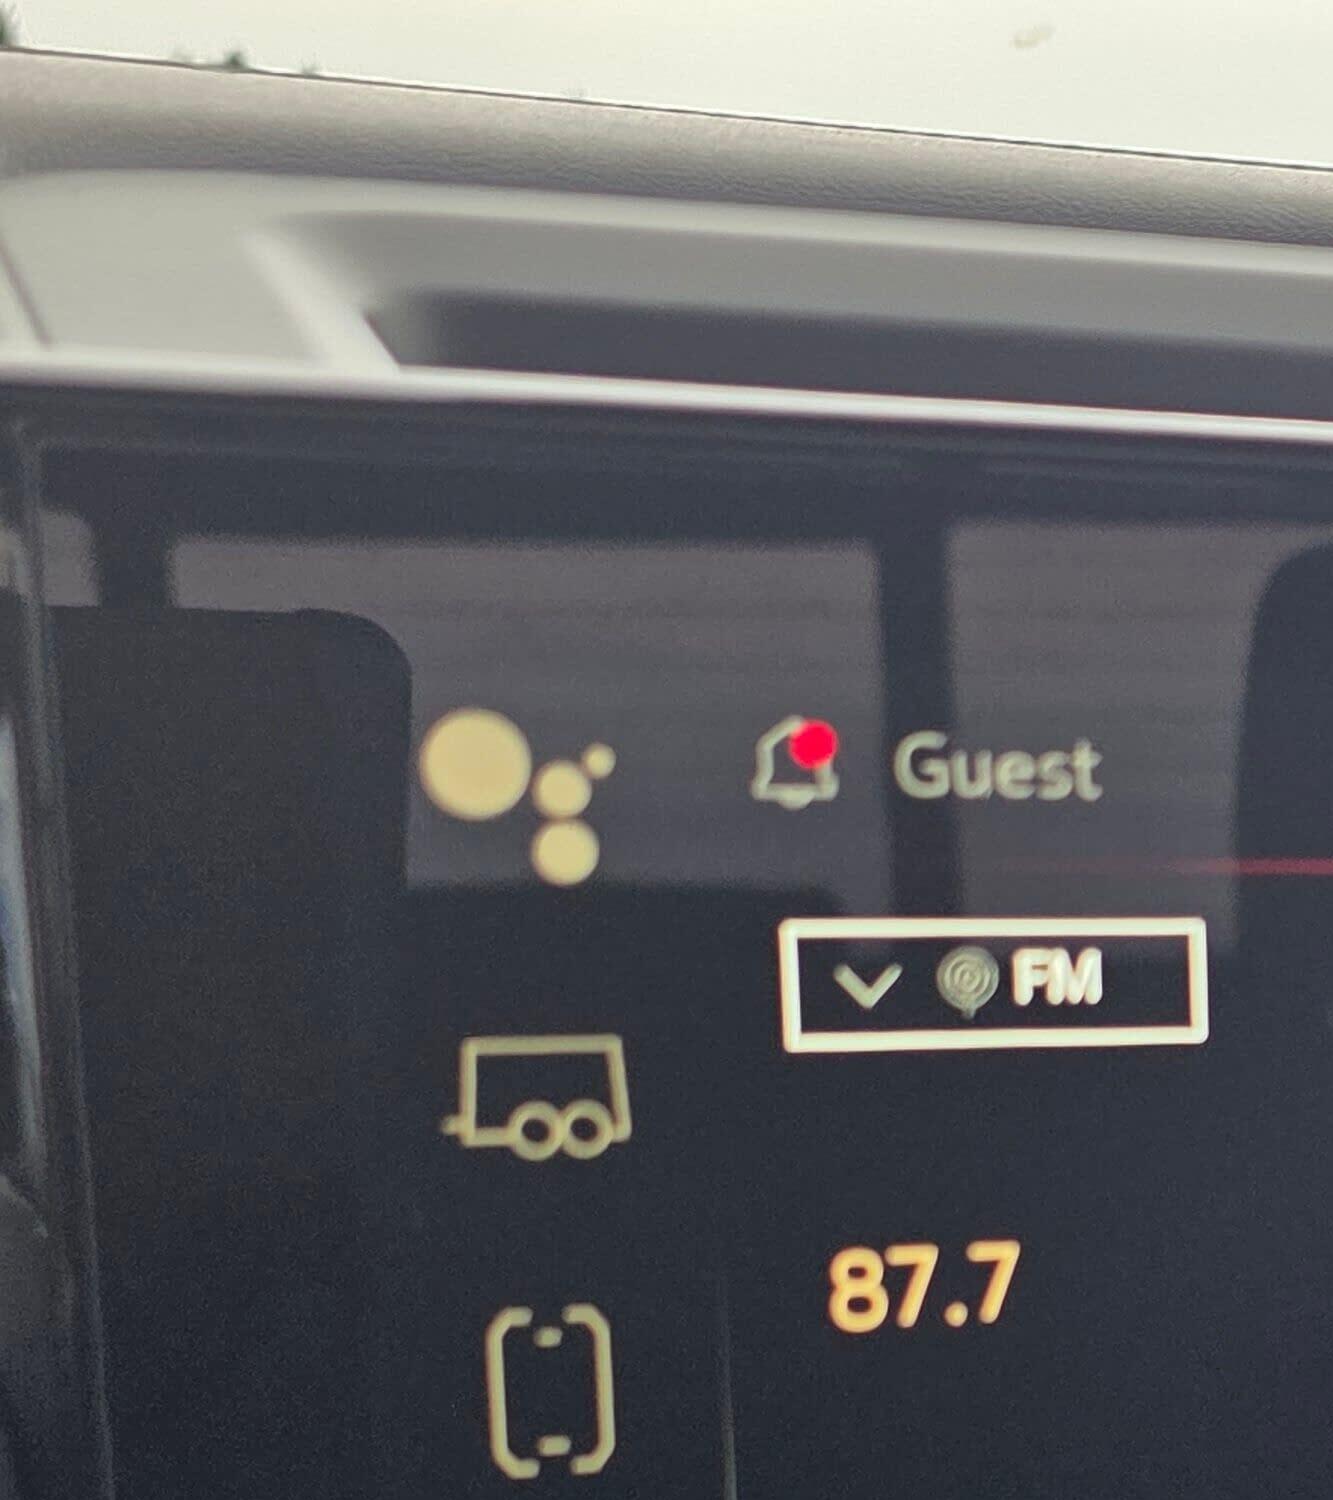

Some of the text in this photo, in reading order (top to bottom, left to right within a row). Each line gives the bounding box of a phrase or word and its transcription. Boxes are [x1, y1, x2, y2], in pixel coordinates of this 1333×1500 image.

[894, 730, 1103, 801] Guest
[1011, 946, 1103, 1006] FM
[828, 1239, 1022, 1334] 87.7
